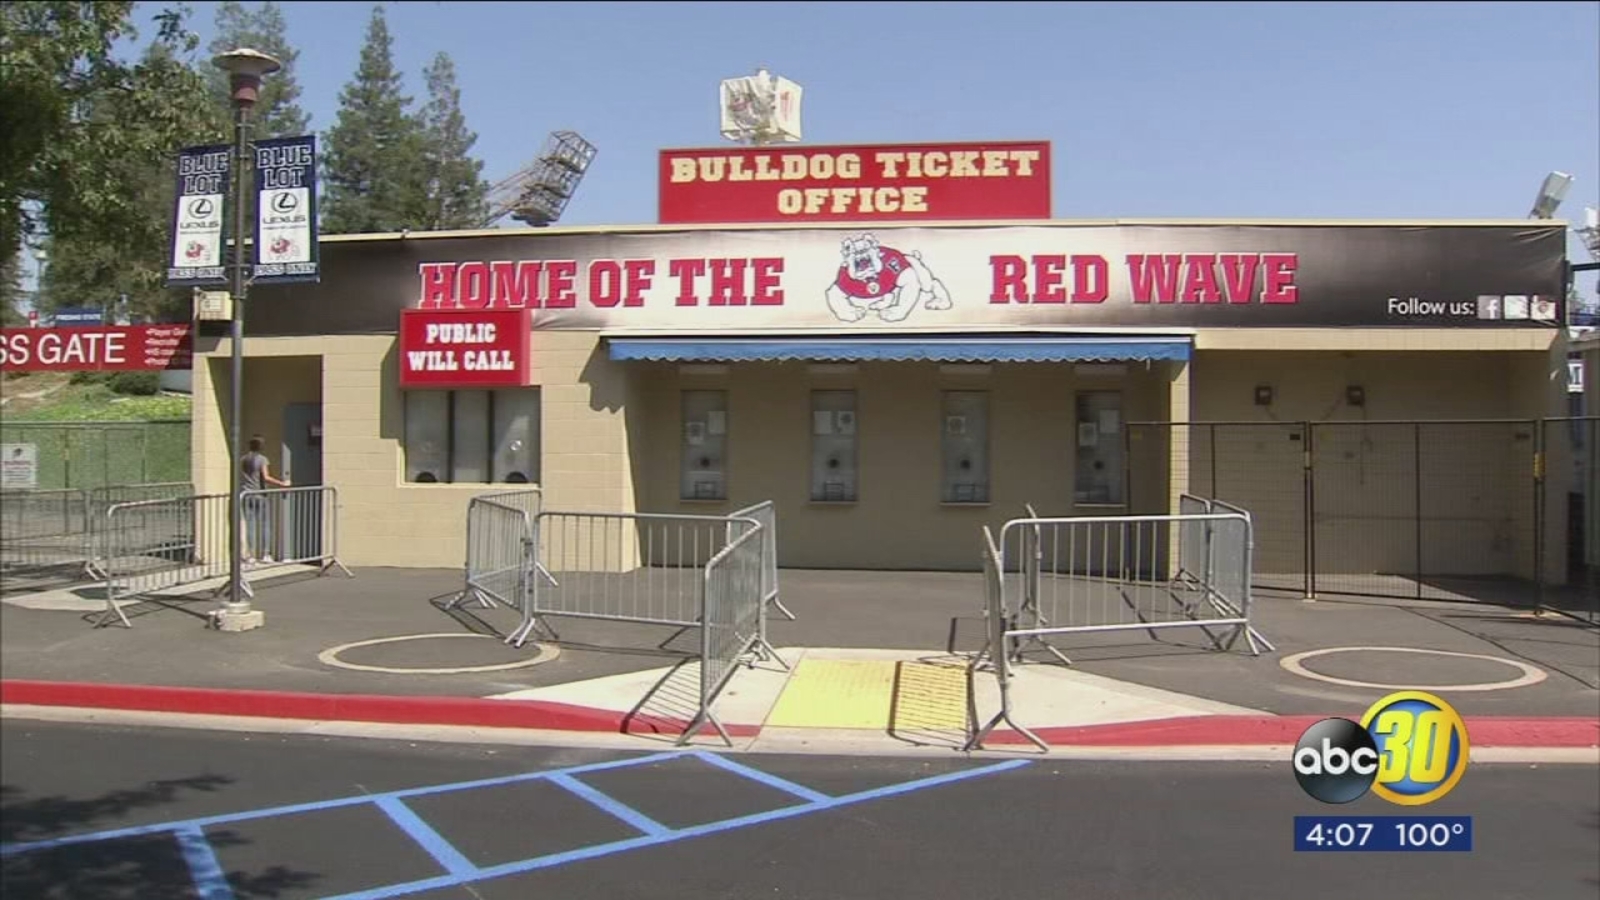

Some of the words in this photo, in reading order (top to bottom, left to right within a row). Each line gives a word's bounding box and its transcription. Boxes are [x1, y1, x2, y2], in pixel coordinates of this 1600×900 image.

[179, 152, 229, 176] BLUE
[257, 144, 312, 169] BLUE
[669, 153, 862, 183] BULLDOG
[875, 150, 1041, 179] TICKET
[184, 173, 222, 195] LOT
[264, 166, 306, 189] LOT
[777, 186, 929, 215] OFFICE
[179, 221, 220, 230] LEXUS
[262, 215, 307, 225] LEXUS
[418, 259, 577, 309] HOME
[588, 258, 656, 308] OF
[669, 256, 785, 306] THE
[989, 253, 1110, 305] RED
[1125, 252, 1299, 305] WAVE
[1387, 297, 1446, 315] Follow
[1450, 300, 1475, 315] us:
[425, 322, 497, 344] PUBLIC
[37, 333, 127, 365] GATE
[407, 350, 458, 371] WILL
[463, 349, 515, 371] CALL
